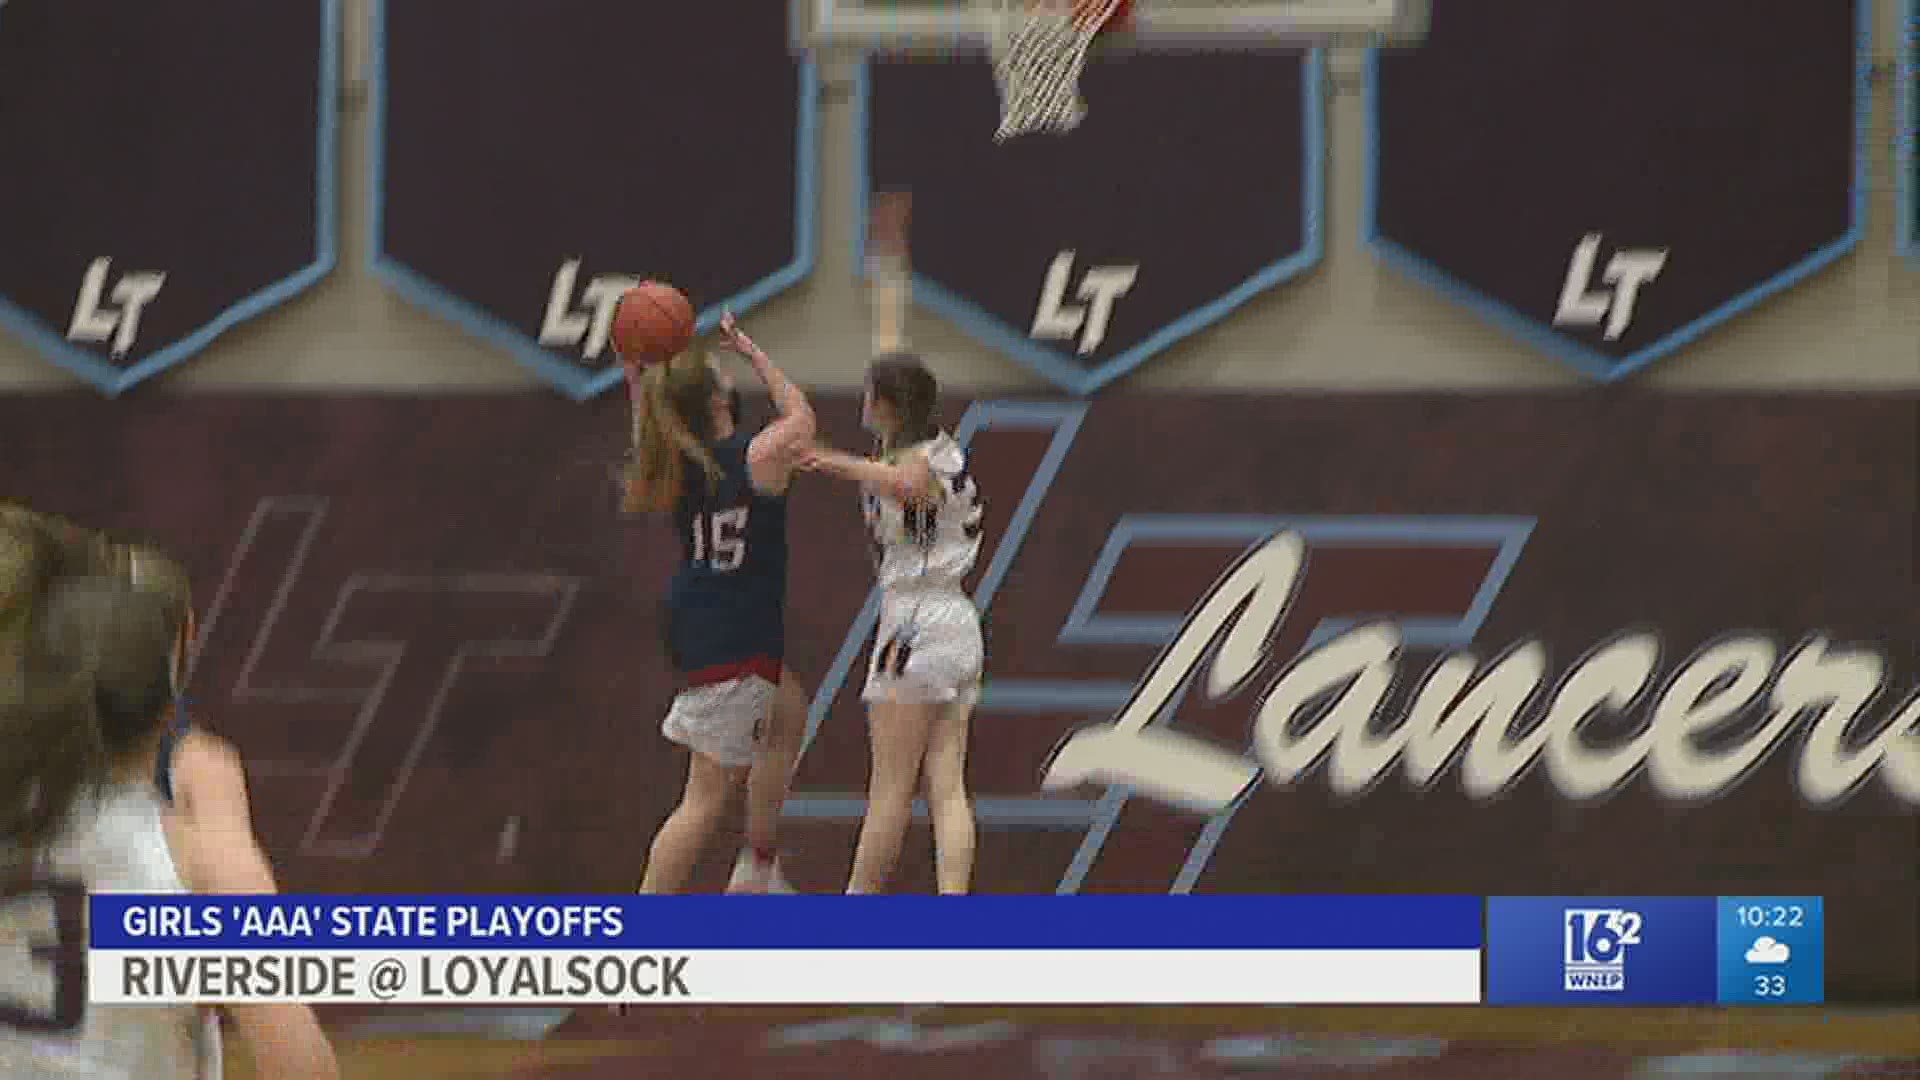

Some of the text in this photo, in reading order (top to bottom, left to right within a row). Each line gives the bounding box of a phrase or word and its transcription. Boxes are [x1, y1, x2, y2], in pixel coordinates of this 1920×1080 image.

[67, 255, 166, 359] LT
[539, 255, 640, 362] LT
[1029, 248, 1139, 355] LT
[1552, 232, 1670, 341] LT
[692, 507, 749, 571] 15
